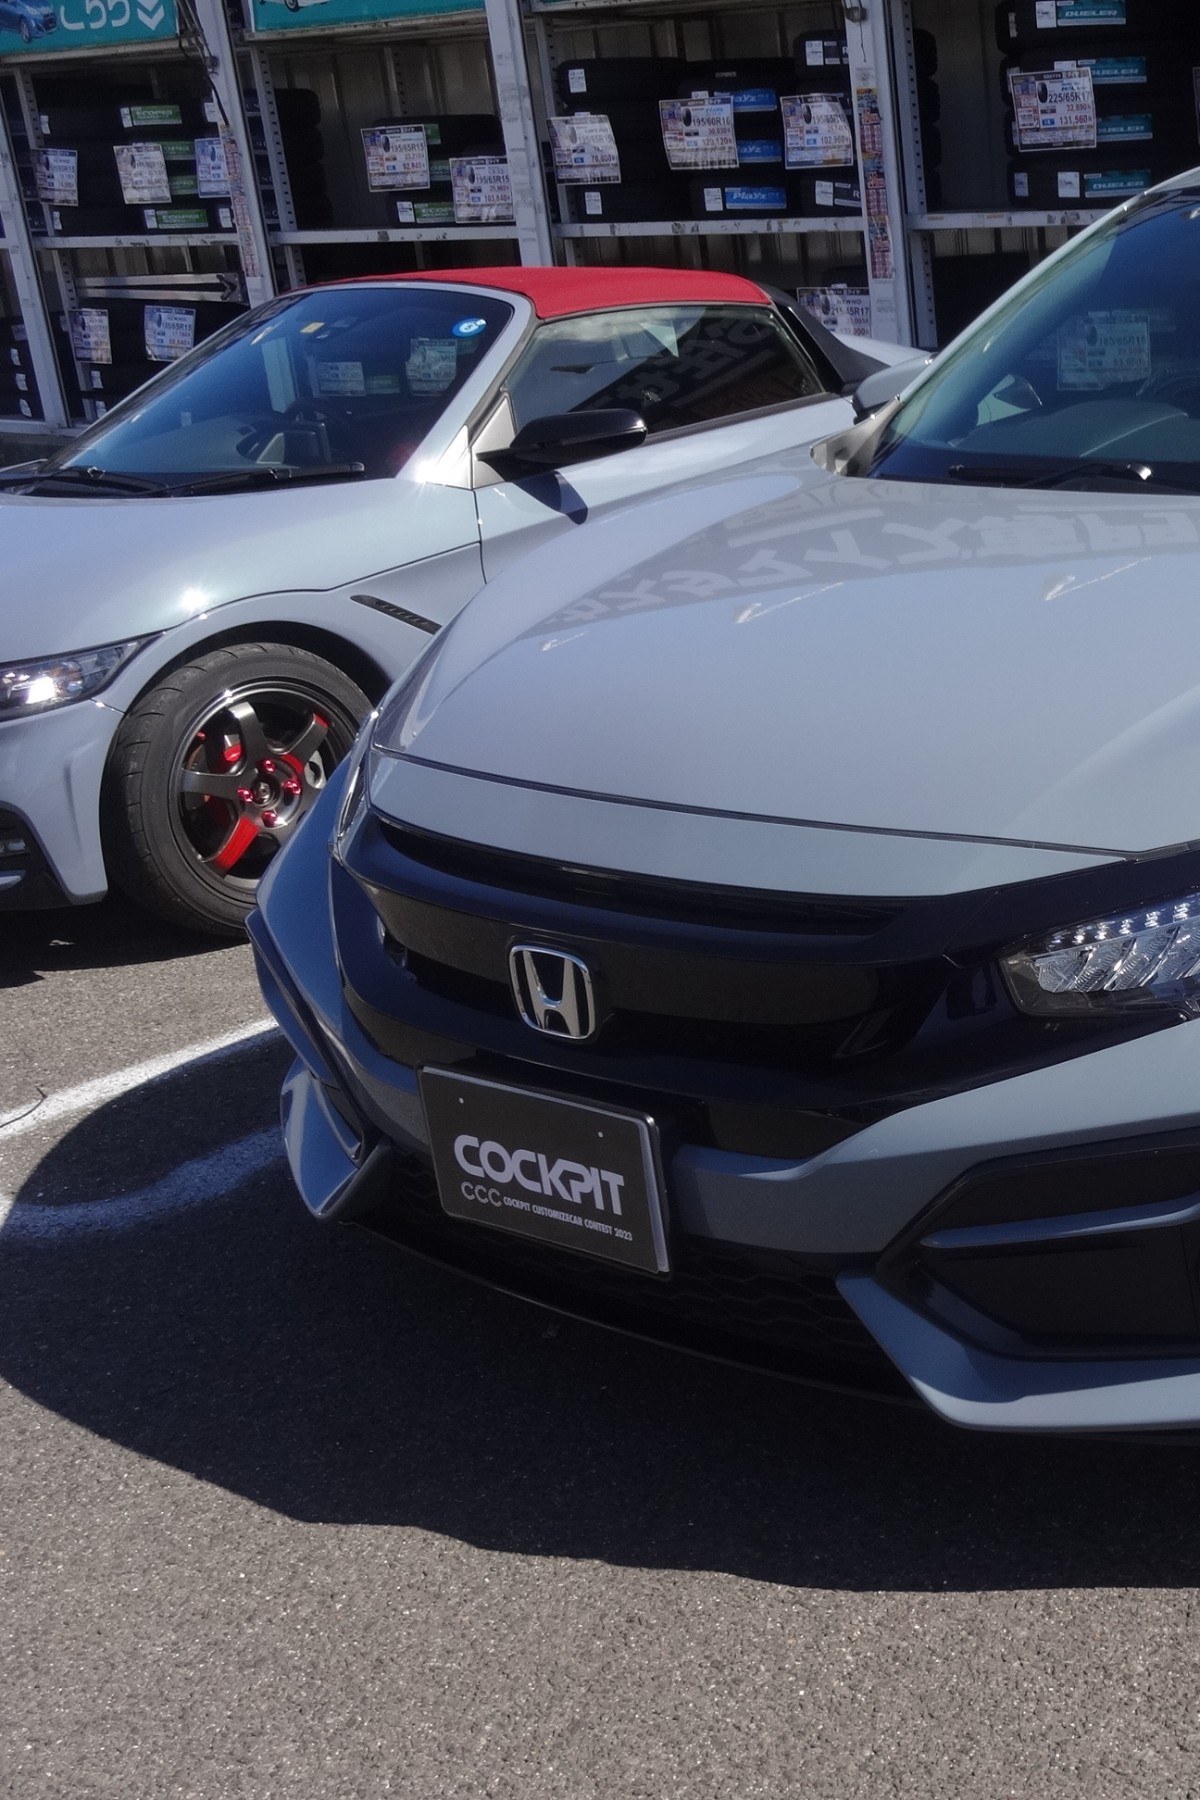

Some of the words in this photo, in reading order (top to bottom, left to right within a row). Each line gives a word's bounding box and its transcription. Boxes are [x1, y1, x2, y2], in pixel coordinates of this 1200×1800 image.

[1065, 9, 1118, 17] DUELER
[1048, 92, 1091, 103] 225/65R17
[691, 116, 731, 127] 195/60R16
[453, 1133, 624, 1216] COCKPIT
[460, 1181, 503, 1208] CCC
[503, 1196, 531, 1213] COCKPIT
[532, 1204, 583, 1228] CUSTOMIZECAR
[584, 1218, 613, 1236] CONTEST
[614, 1228, 633, 1242] 2023
